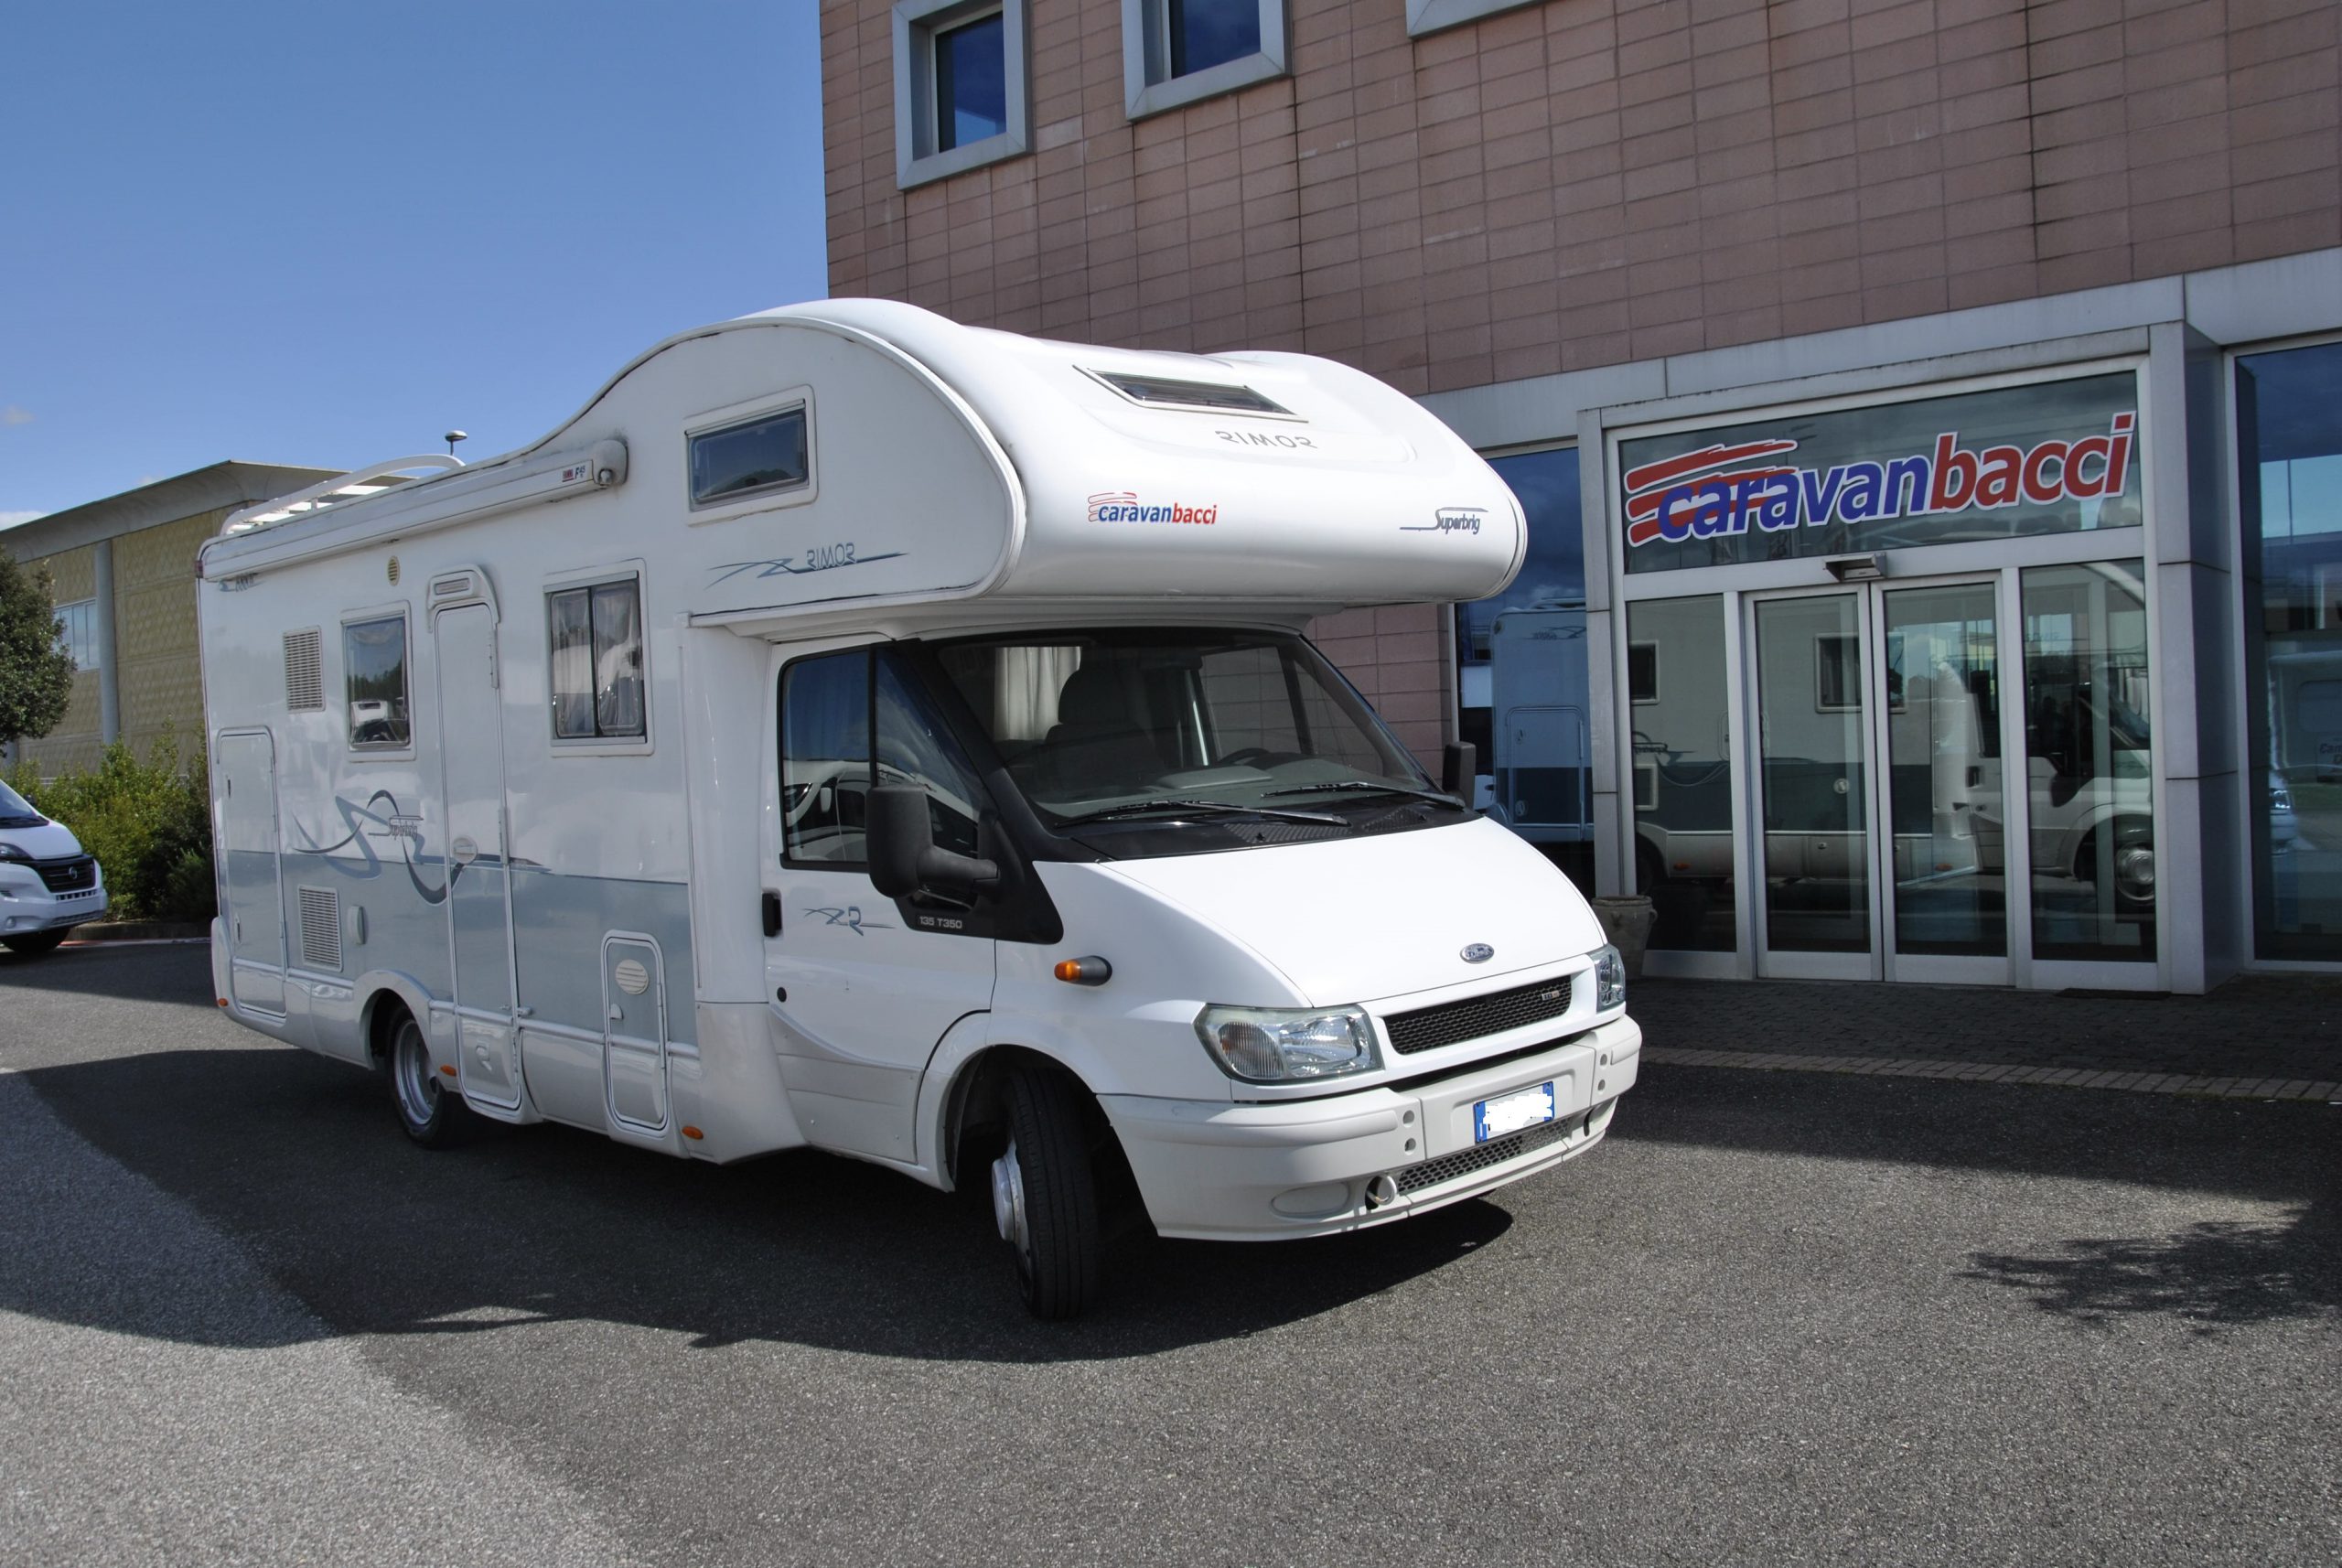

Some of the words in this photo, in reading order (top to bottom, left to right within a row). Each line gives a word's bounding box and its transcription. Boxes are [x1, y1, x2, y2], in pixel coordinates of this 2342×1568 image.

[1214, 430, 1318, 449] RIMOR
[1653, 411, 2137, 542] caravanbacci
[1098, 501, 1217, 524] caravanbacci
[1399, 506, 1489, 535] Superbrig
[806, 542, 857, 571] RIMOR
[919, 916, 935, 926] 135
[937, 918, 962, 929] T350
